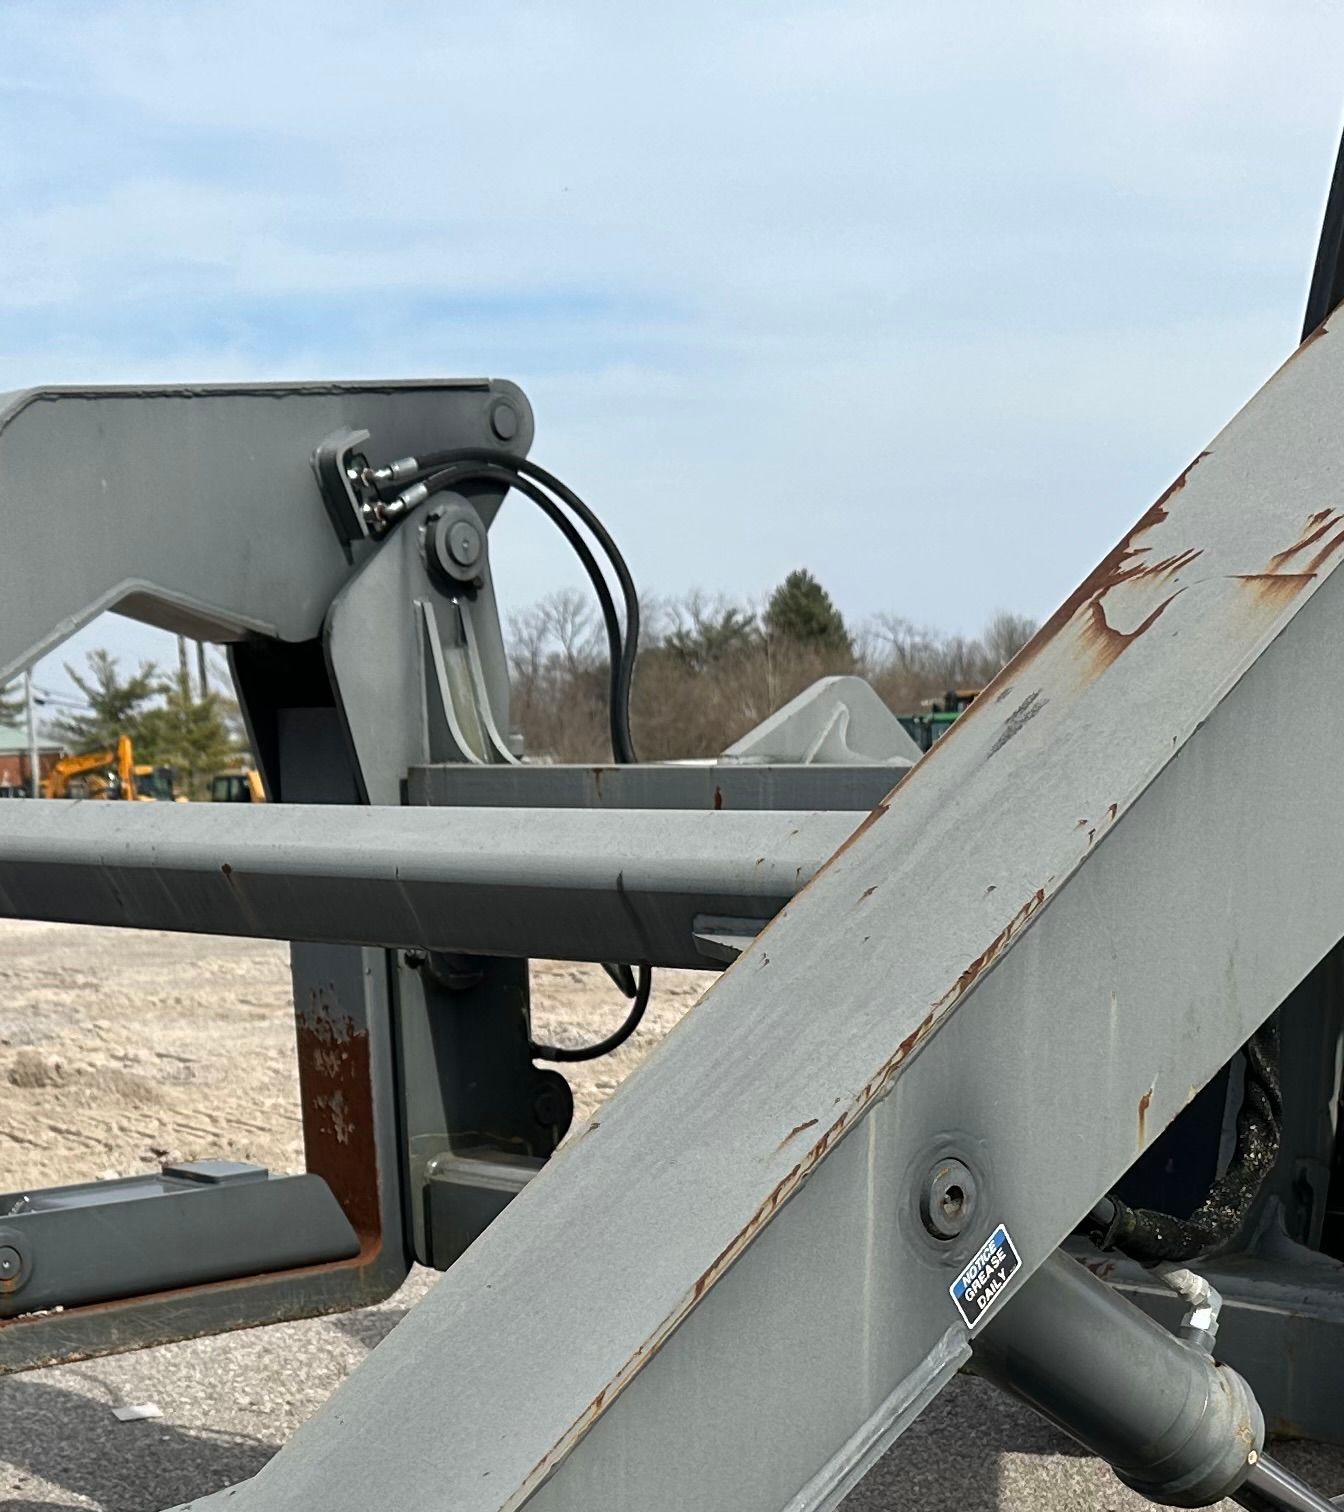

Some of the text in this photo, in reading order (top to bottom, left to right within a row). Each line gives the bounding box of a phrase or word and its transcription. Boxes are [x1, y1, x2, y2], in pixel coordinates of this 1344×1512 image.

[961, 1239, 997, 1289] NOTICE
[964, 1246, 1007, 1302] GREASE
[976, 1267, 1006, 1310] DAILY
